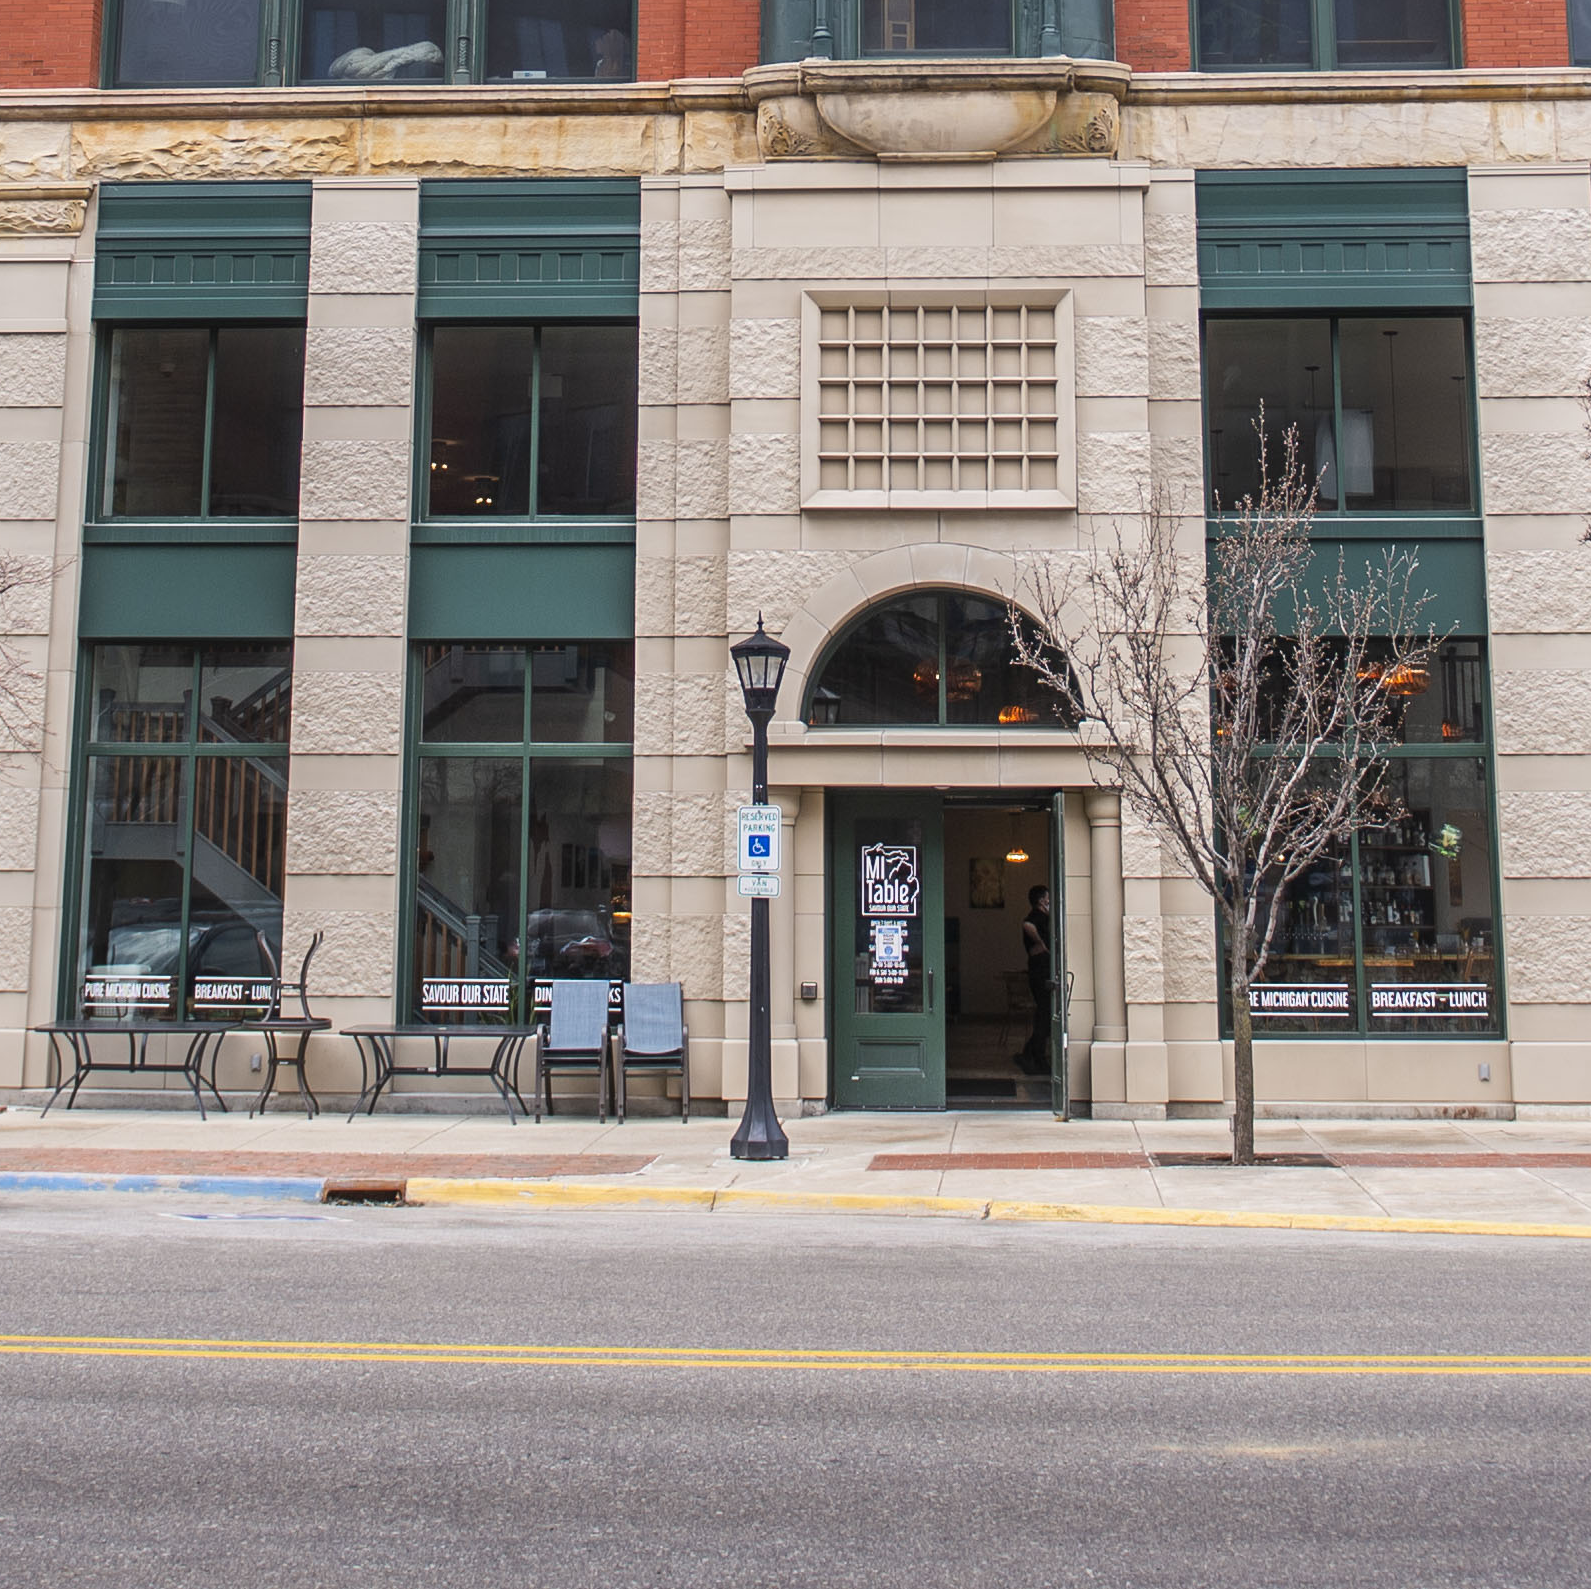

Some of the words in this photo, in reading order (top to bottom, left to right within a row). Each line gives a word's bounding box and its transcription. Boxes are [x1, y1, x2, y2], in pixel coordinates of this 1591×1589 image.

[741, 812, 778, 821] RESERVED
[743, 823, 776, 832] PARKING
[866, 855, 885, 880] MI
[866, 878, 909, 904] Table
[84, 982, 104, 998] PURE
[105, 982, 142, 999] MICHIGAN
[142, 983, 171, 999] CUISINE
[195, 983, 243, 1000] BREAKFAST
[422, 984, 459, 1004] SAVOUR
[461, 985, 482, 1004] OUR
[483, 986, 509, 1004] STATE
[1261, 991, 1309, 1008] MICHIGAN
[1310, 991, 1349, 1008] CUISINE
[1372, 991, 1436, 1008] BREAKFAST
[1449, 991, 1488, 1008] LUNCH
